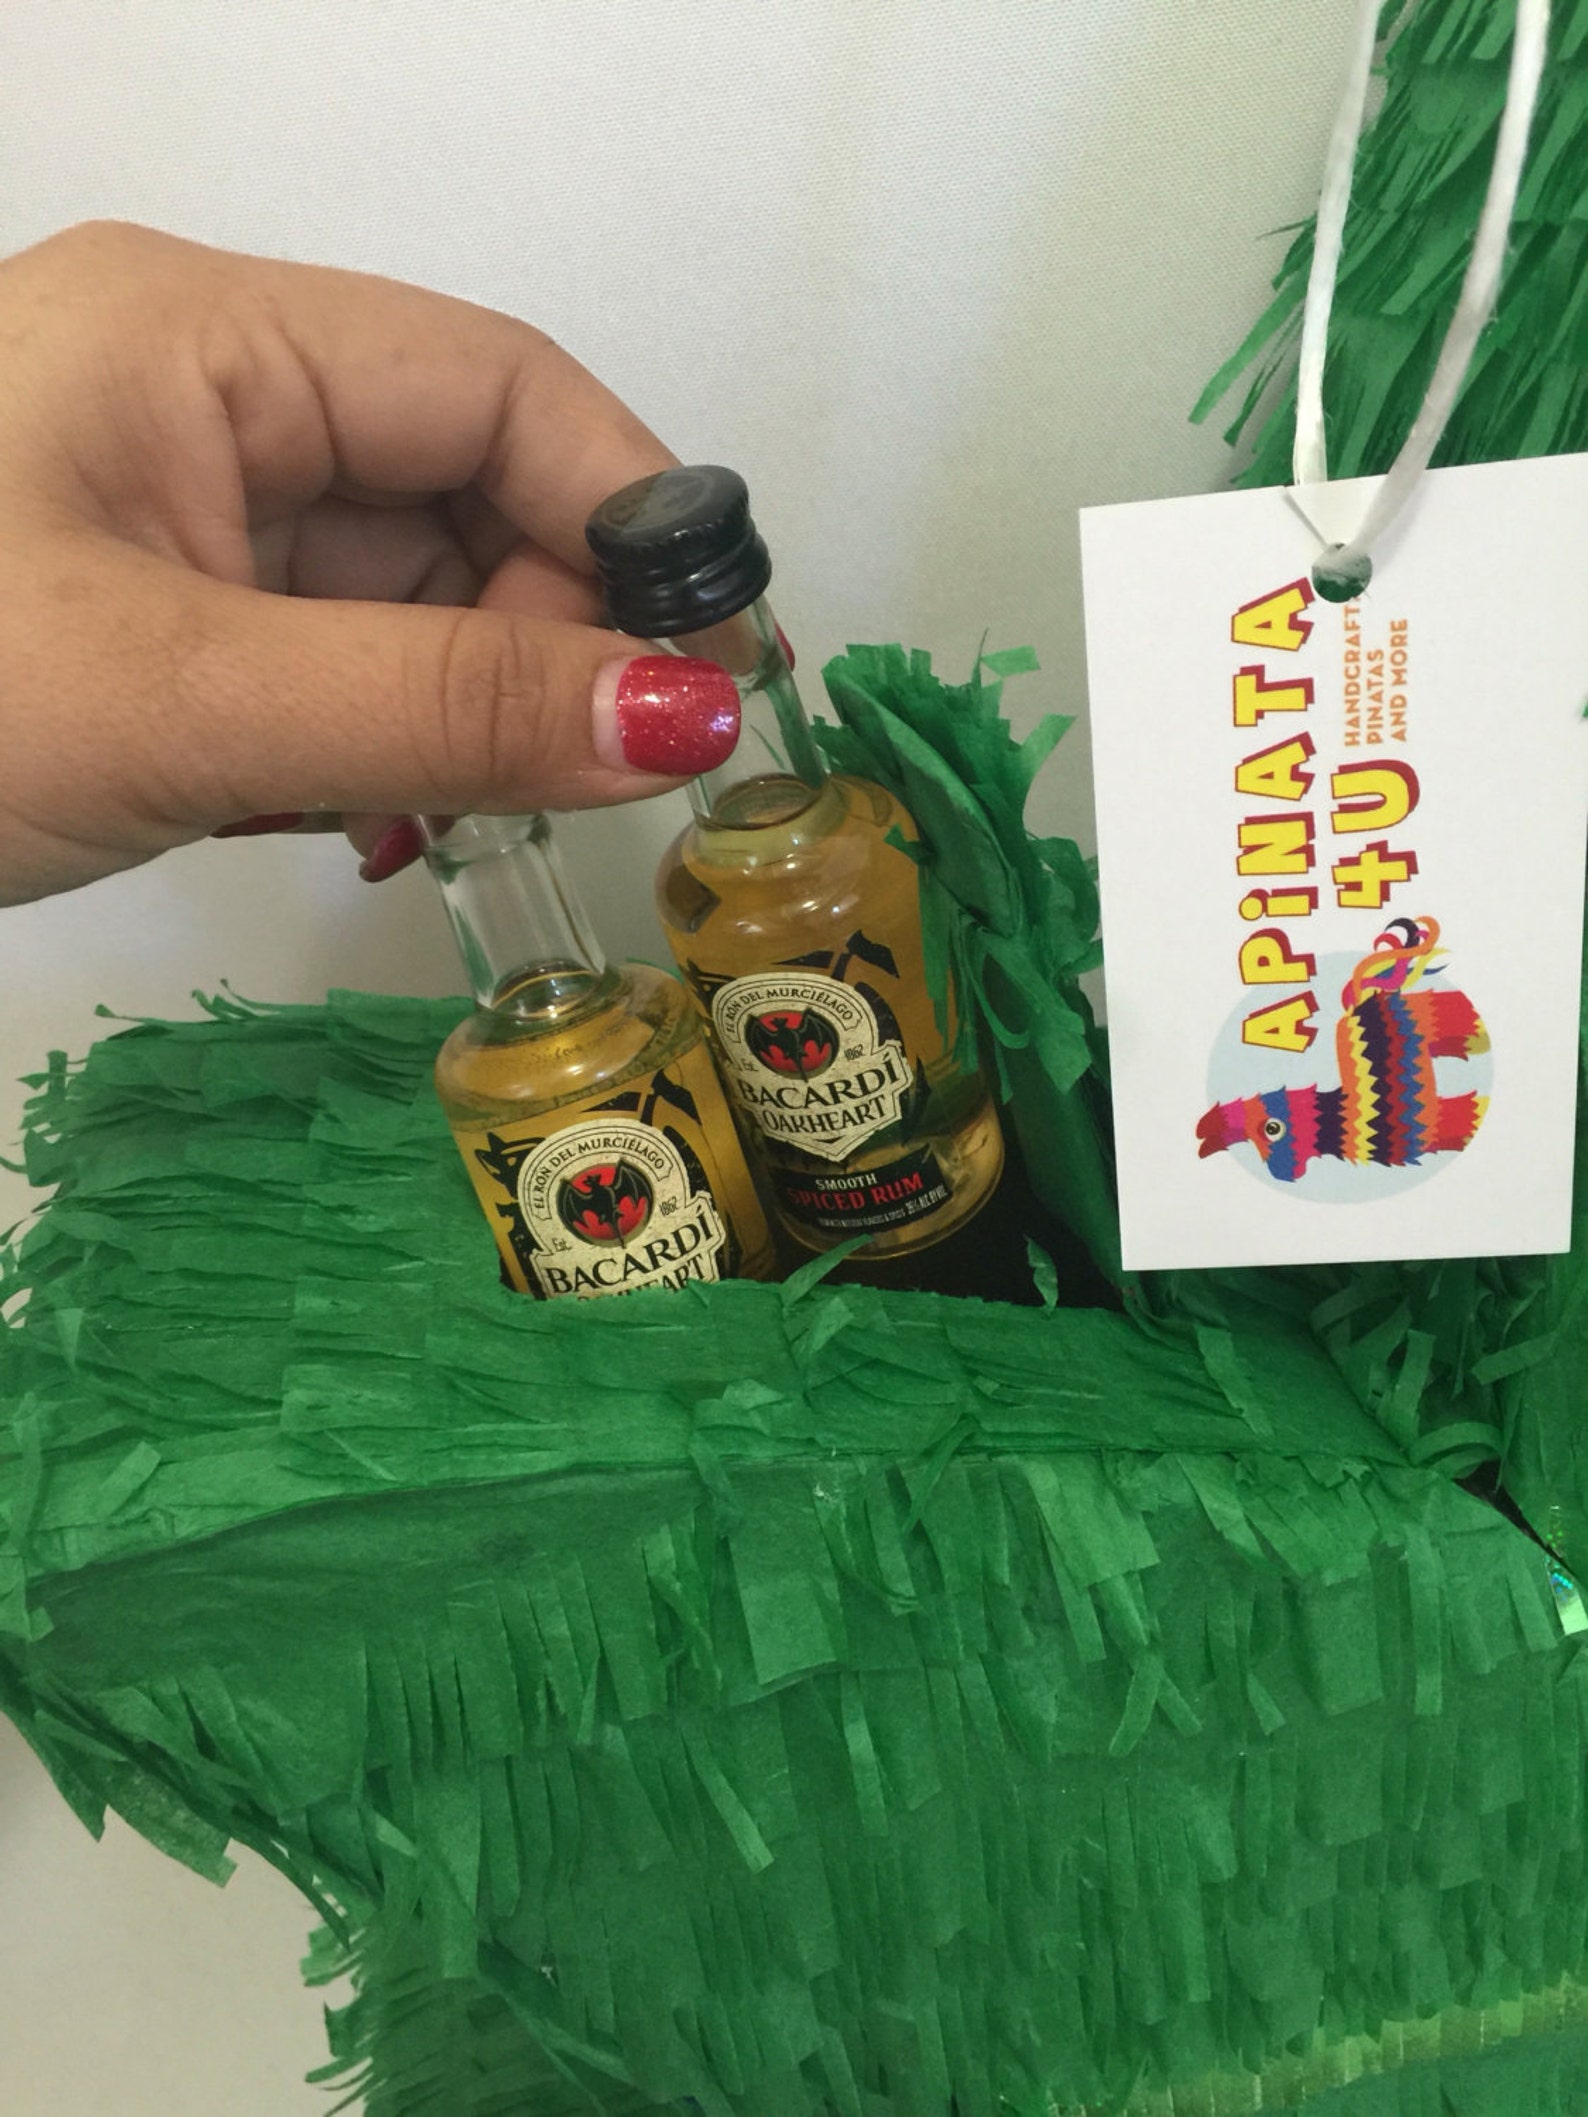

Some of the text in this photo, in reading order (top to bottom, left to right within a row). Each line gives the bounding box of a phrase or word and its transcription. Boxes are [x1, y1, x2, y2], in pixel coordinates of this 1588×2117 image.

[1344, 597, 1361, 747] HANDCRAFT
[1390, 619, 1408, 742] AND MORE
[1366, 648, 1384, 744] PINATAS
[1331, 759, 1420, 909] 4U
[725, 1001, 741, 1021] RON
[739, 990, 765, 1005] DEL
[736, 1053, 900, 1110] BACARDÍ
[762, 1095, 888, 1134] OAKHEART
[549, 1148, 577, 1168] DEL
[533, 1166, 552, 1194] RON
[787, 1187, 866, 1211] SPICED
[870, 1171, 924, 1205] RUM
[815, 1172, 878, 1192] SMOOTH
[534, 1193, 545, 1210] EL
[545, 1205, 714, 1294] BACARDÍ
